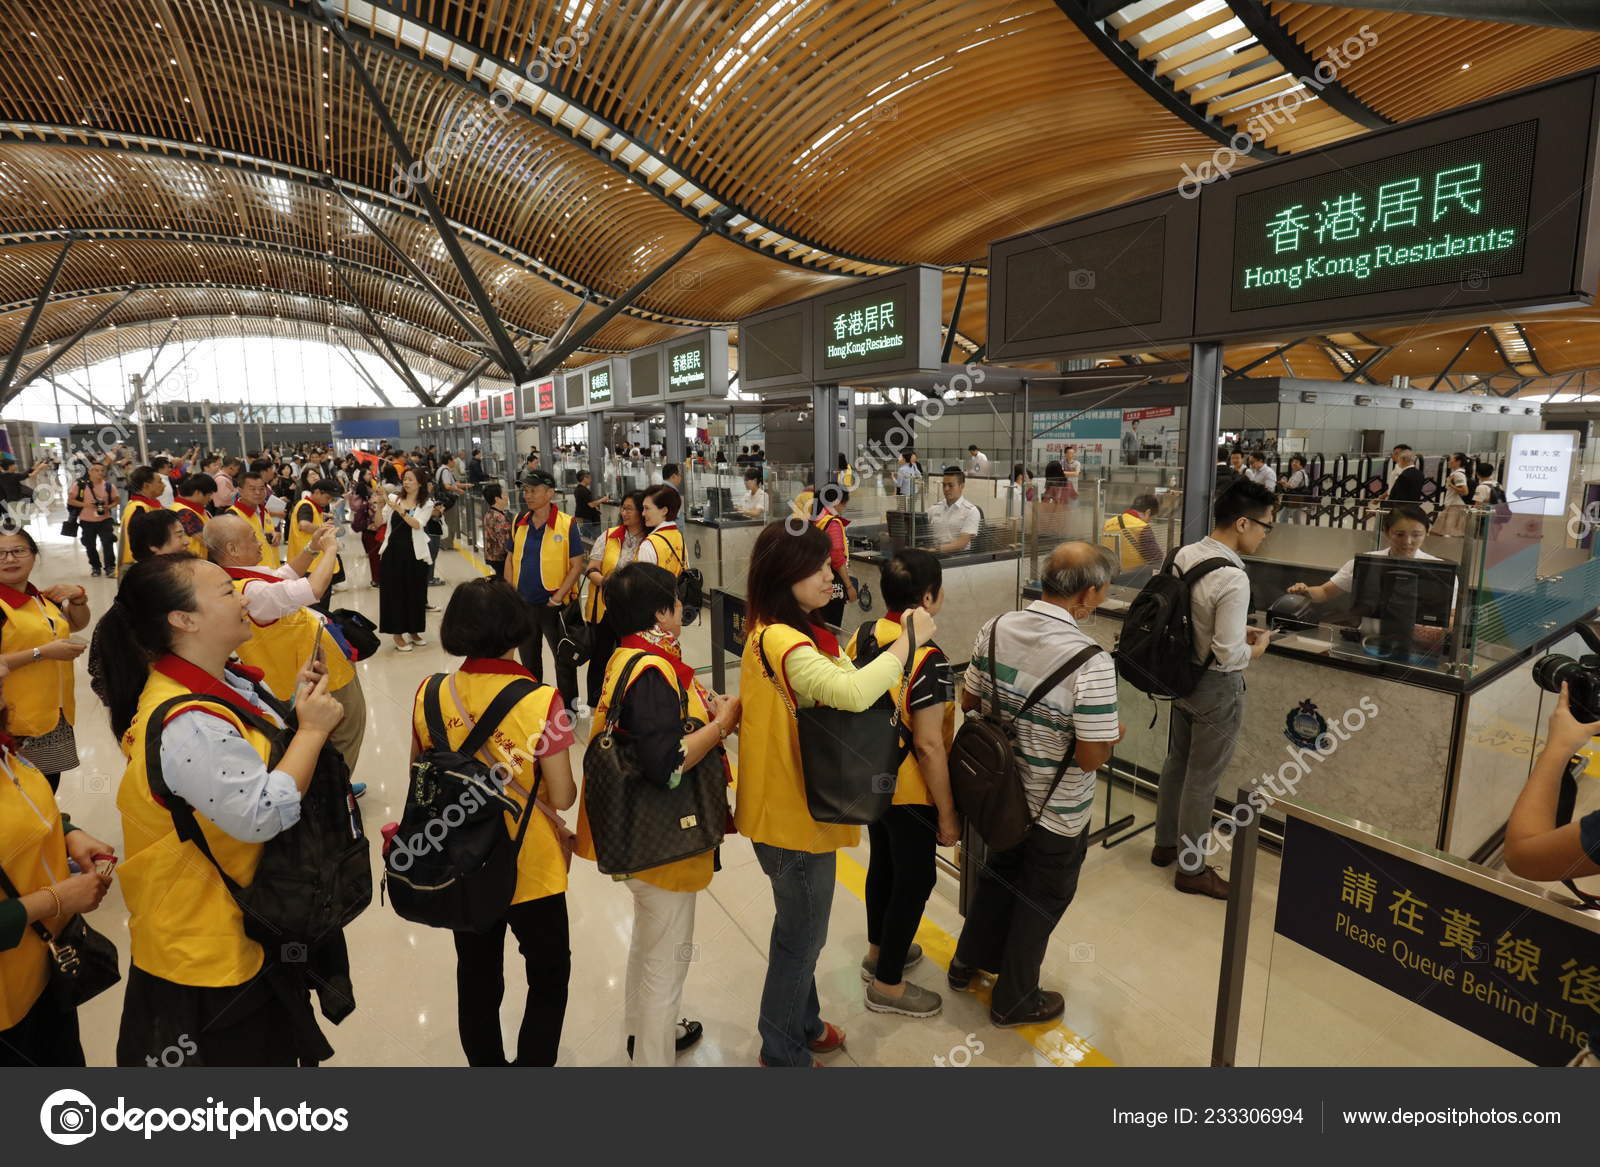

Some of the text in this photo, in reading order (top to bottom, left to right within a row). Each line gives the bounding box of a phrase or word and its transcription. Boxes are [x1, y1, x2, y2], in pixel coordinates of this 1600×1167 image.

[1265, 163, 1483, 254] 香港居民
[1244, 227, 1515, 289] Hong Kong Residents
[833, 302, 894, 340] 香港居民
[827, 334, 904, 359] Hong Kong Residents
[1518, 465, 1558, 473] CUSTOMS
[1525, 472, 1549, 480] HALL
[1335, 912, 1589, 1049] Please Queue Behind The
